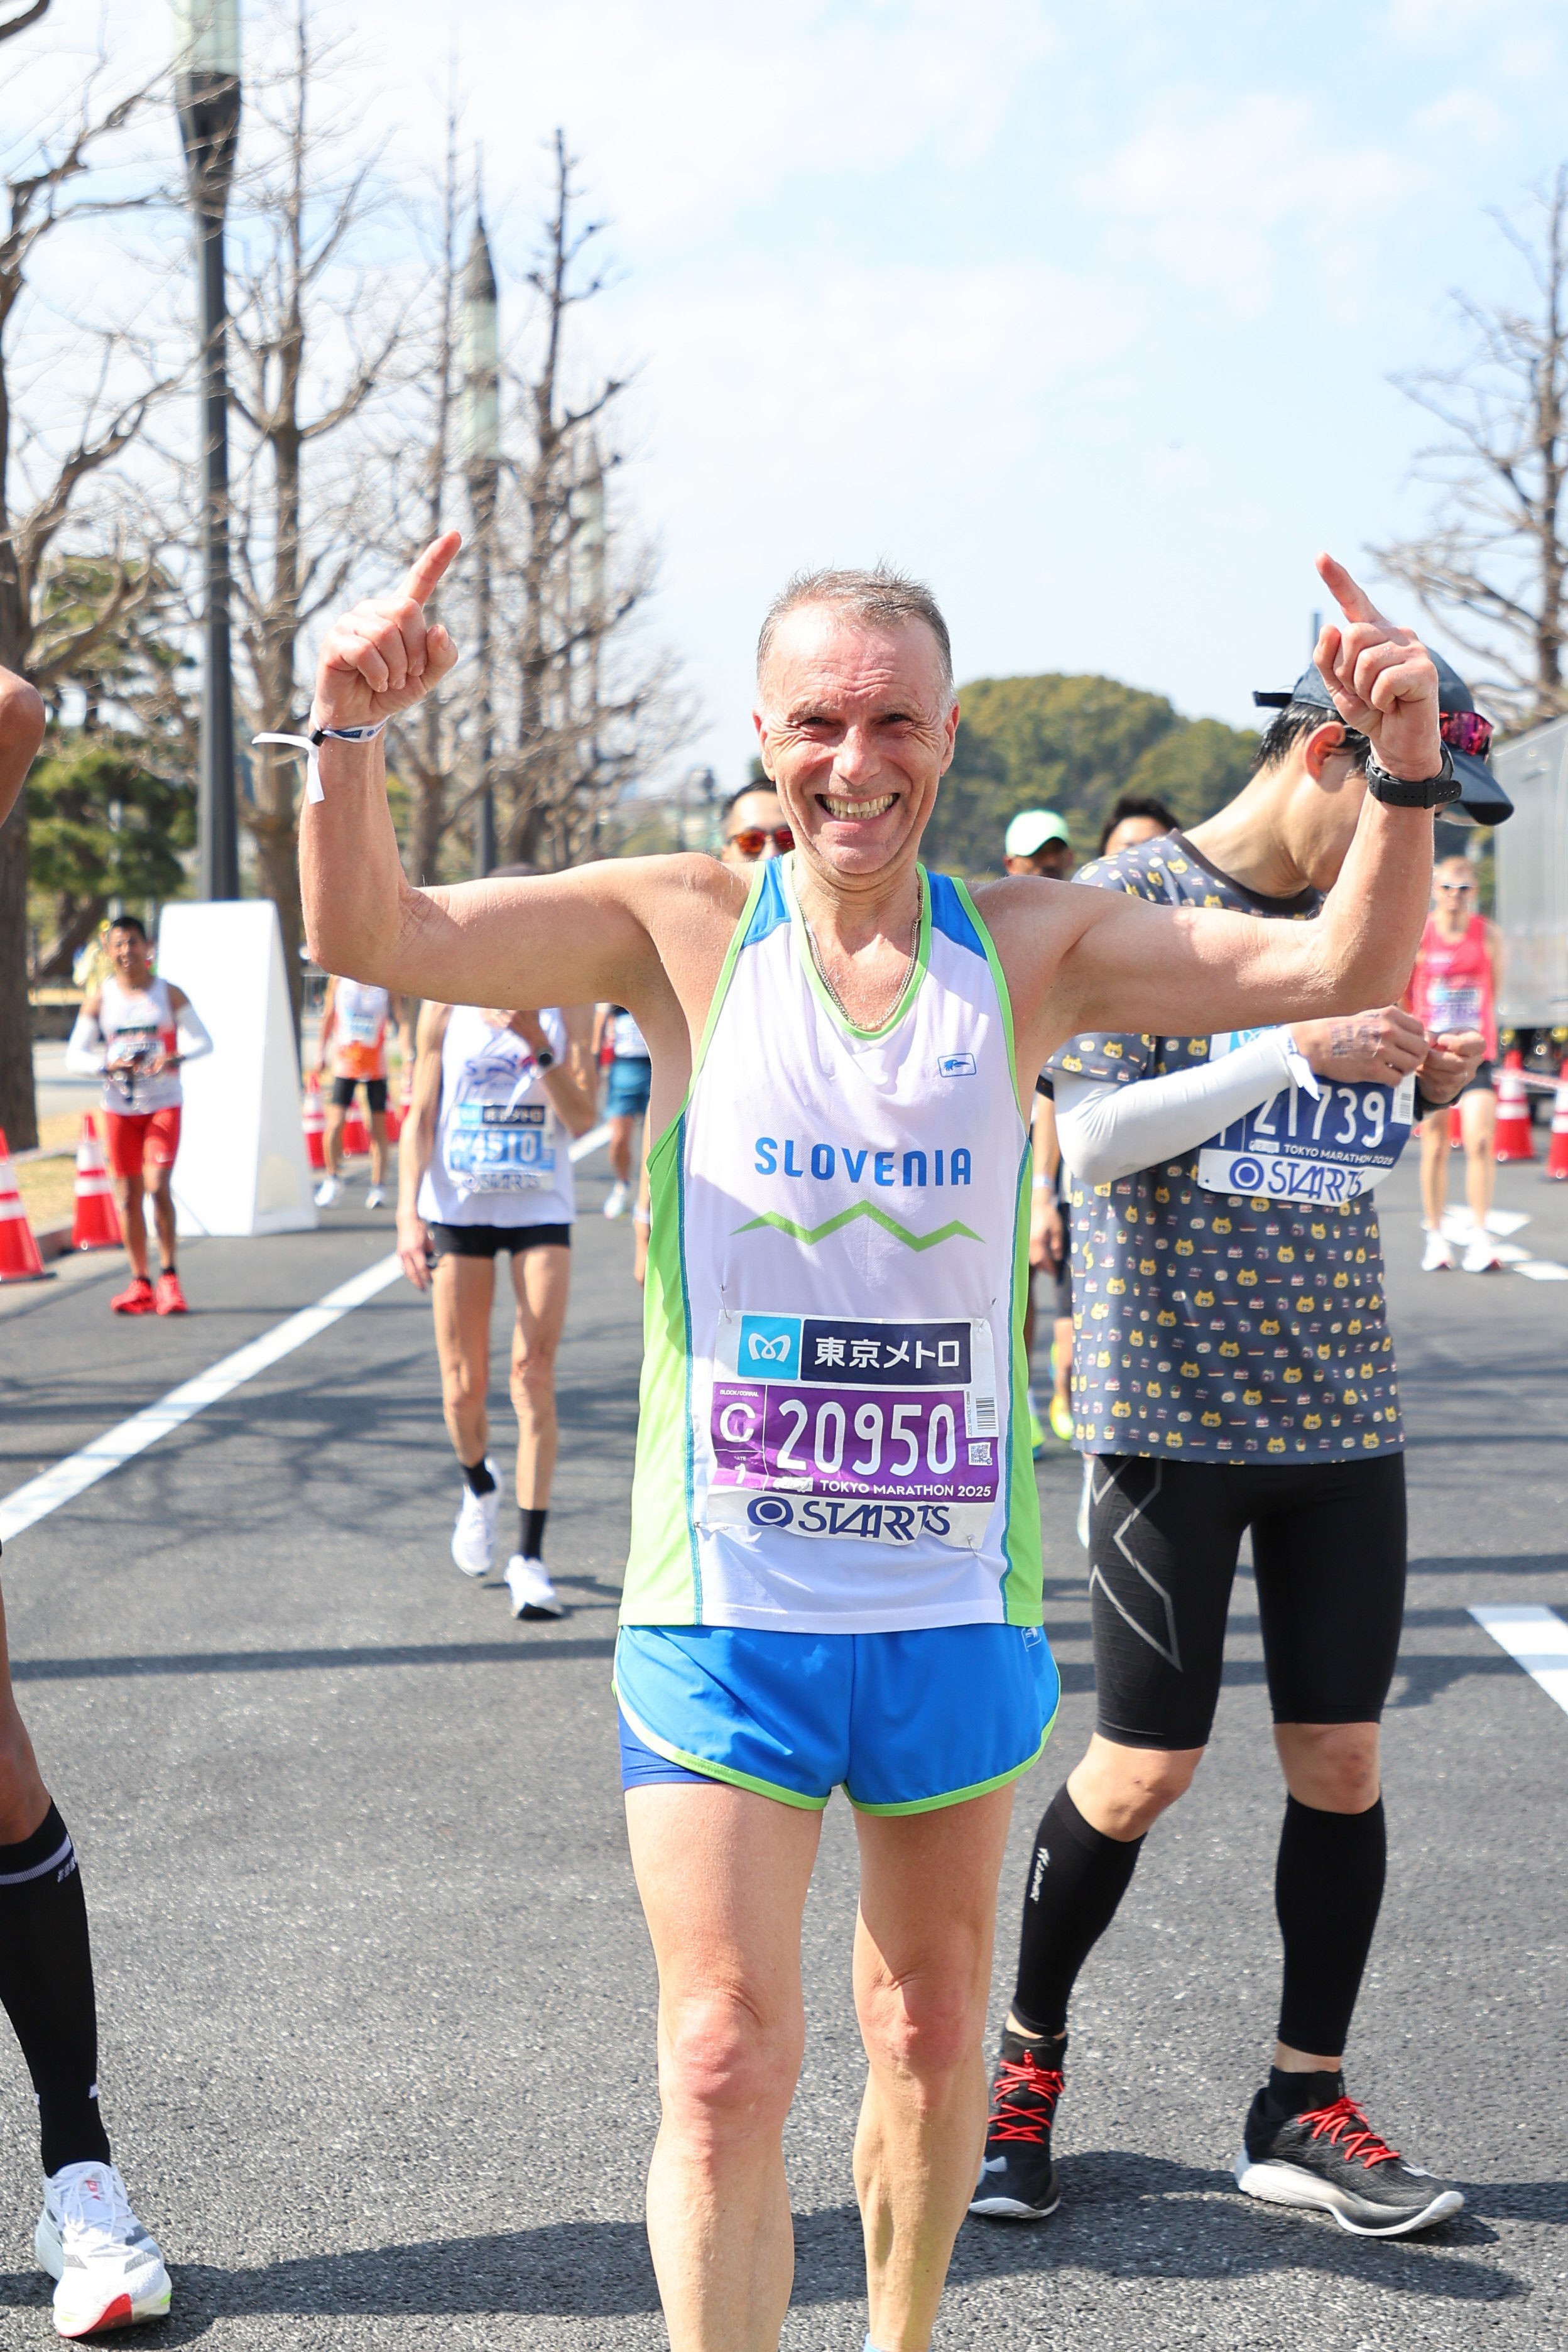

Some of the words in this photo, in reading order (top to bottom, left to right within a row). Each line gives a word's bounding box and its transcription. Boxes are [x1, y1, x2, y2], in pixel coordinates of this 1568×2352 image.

[754, 1137, 971, 1186] SLOVENIA
[1283, 1144, 1319, 1157] TOKYO
[814, 1336, 960, 1369] 東京メトロ
[720, 1403, 756, 1442] C
[776, 1399, 956, 1476] 20950
[734, 1463, 746, 1484] 1
[820, 1479, 870, 1494] TOKYO
[873, 1484, 954, 1497] MARATHON
[957, 1486, 991, 1497] 2025
[798, 1501, 950, 1541] STARTS
